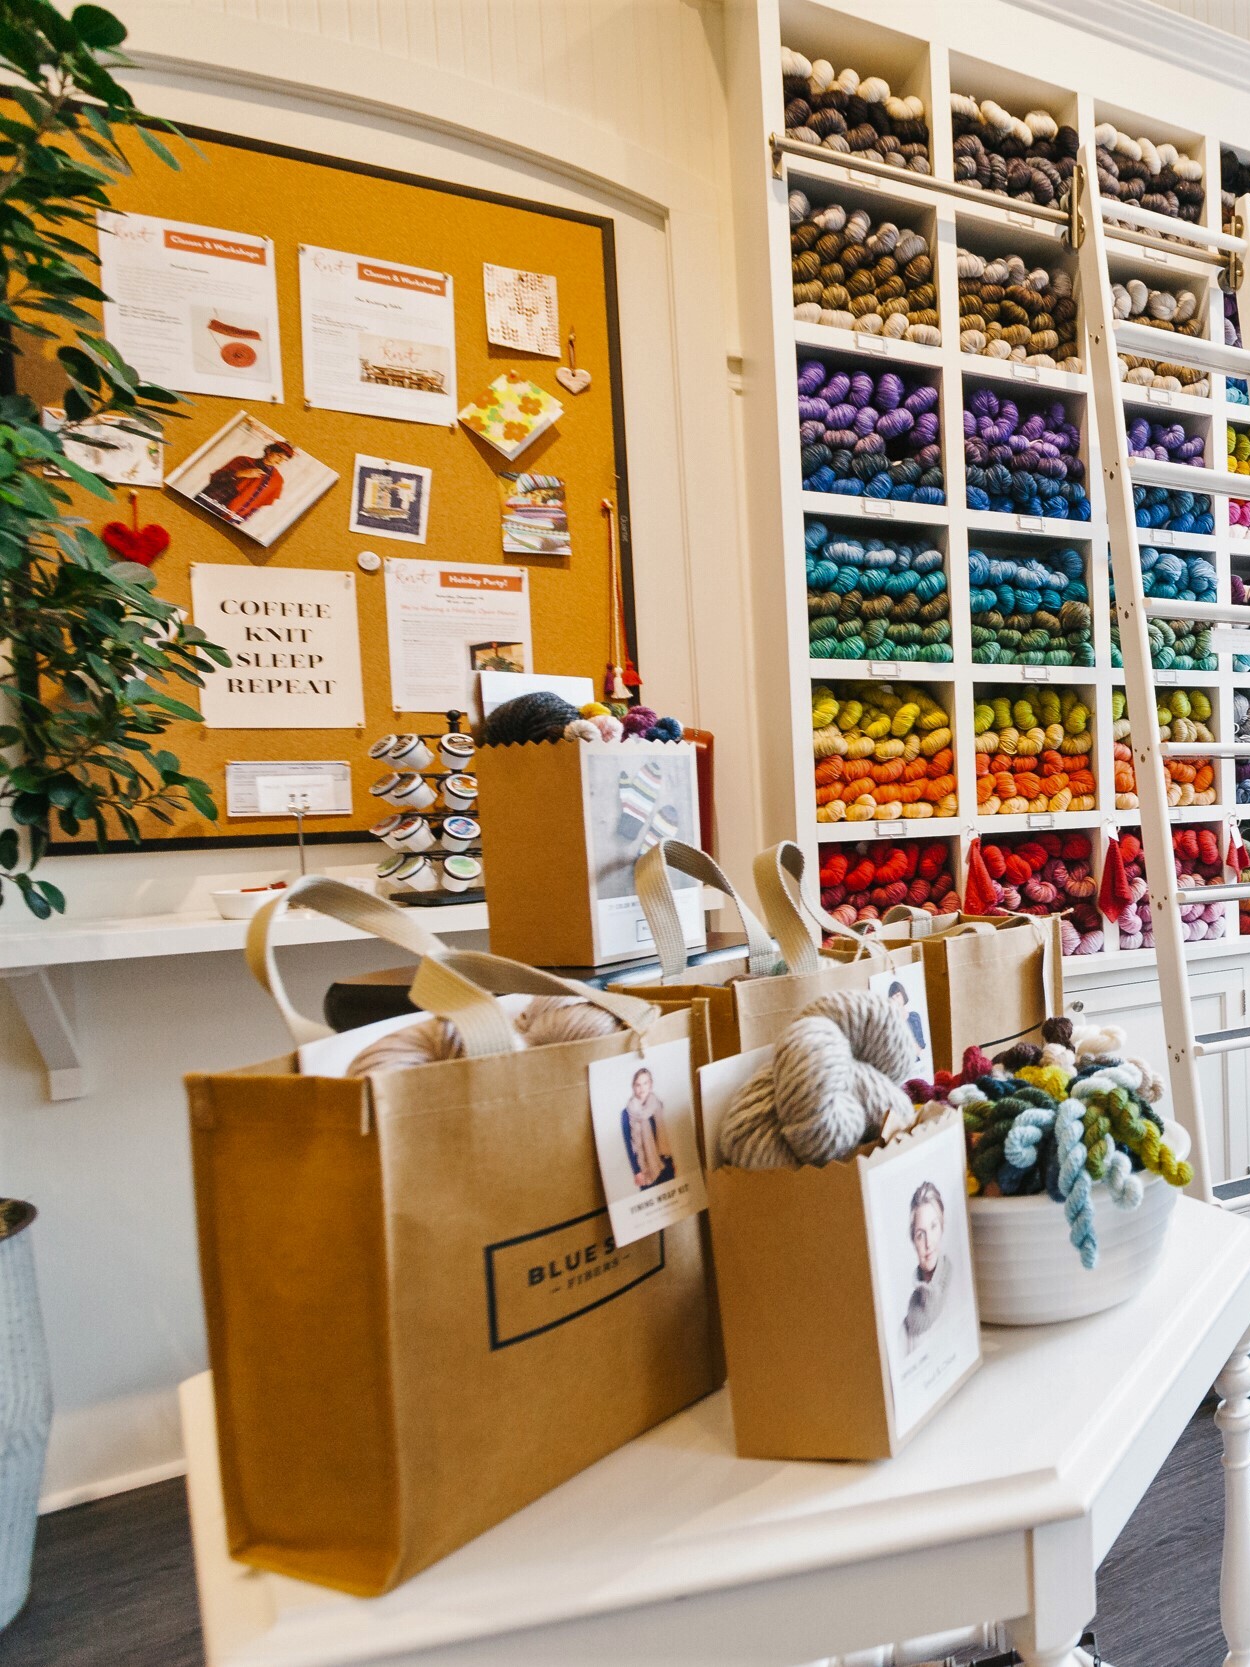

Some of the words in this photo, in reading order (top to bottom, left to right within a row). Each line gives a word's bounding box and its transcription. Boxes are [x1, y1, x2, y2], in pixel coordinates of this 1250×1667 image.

[170, 235, 204, 249] Classes
[214, 243, 261, 259] Workshops
[363, 269, 392, 281] Classes
[401, 276, 441, 292] Workshops
[449, 575, 481, 588] Holiday
[483, 577, 508, 589] Party!
[220, 599, 332, 619] COFFEE
[244, 626, 314, 643] KNIT
[236, 652, 324, 669] SLEEP
[227, 678, 337, 695] REPEAT
[527, 1243, 599, 1287] BLUE
